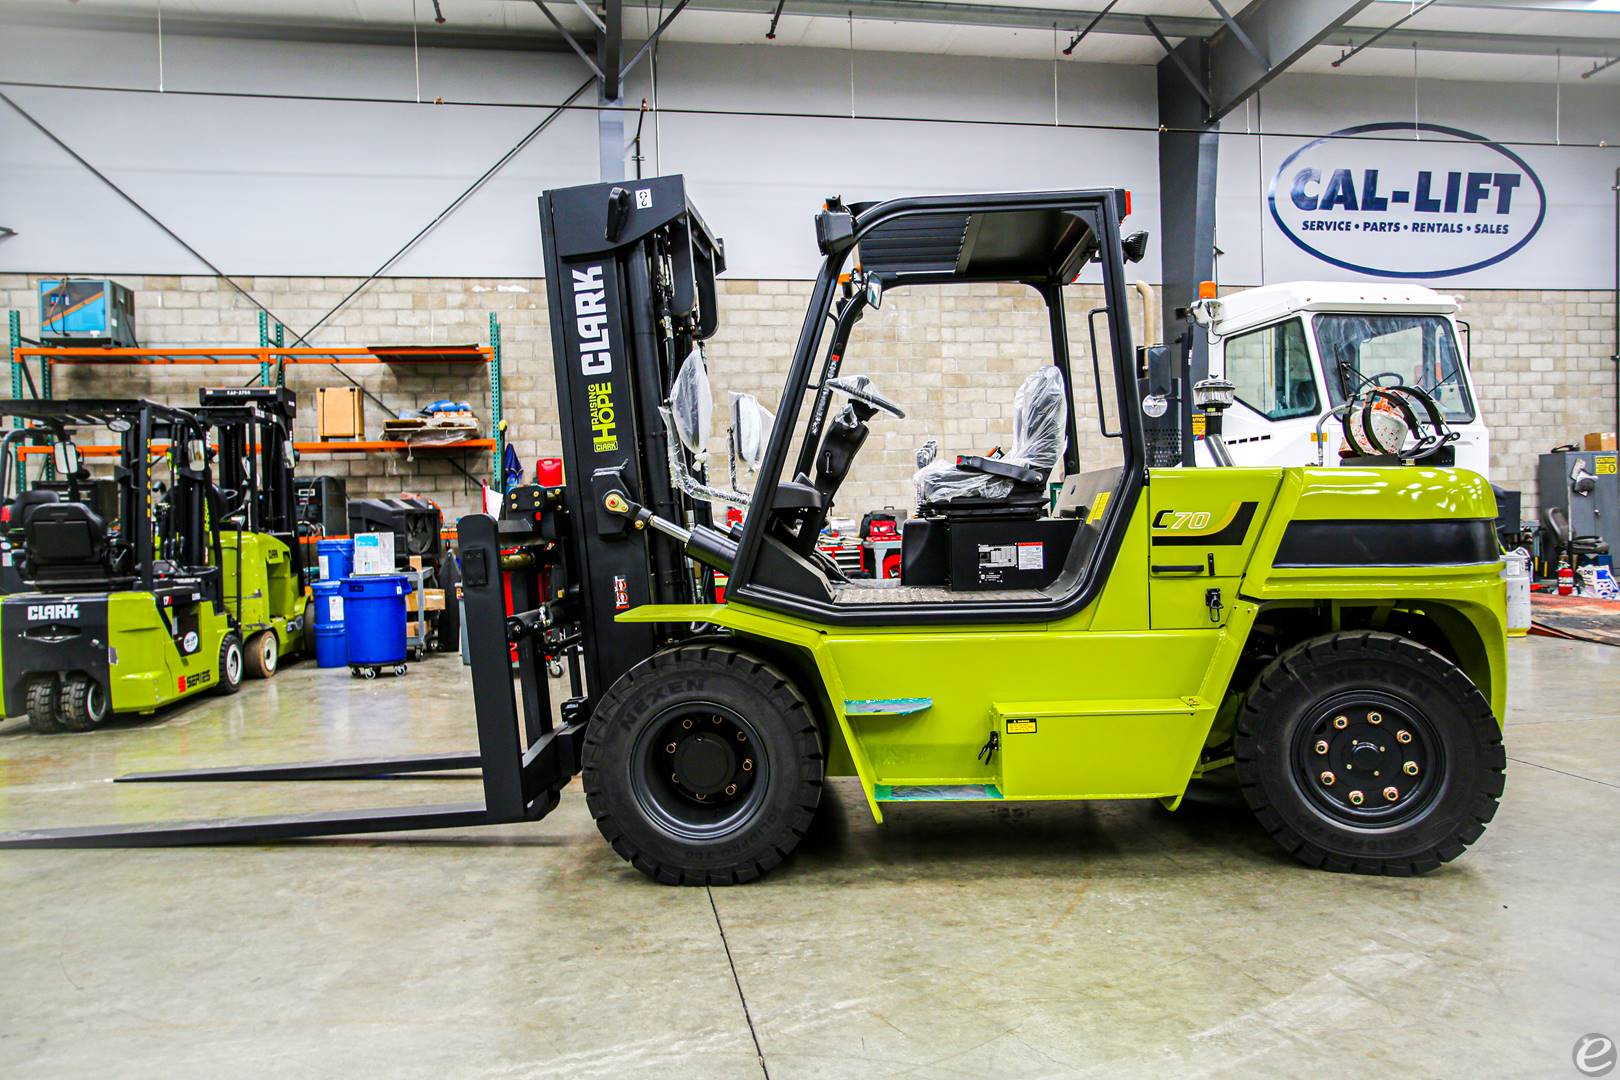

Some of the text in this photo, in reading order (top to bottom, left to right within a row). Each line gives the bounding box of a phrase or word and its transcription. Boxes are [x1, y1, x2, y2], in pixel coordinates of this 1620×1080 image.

[1290, 168, 1521, 214] CAL-LIFT
[1302, 220, 1509, 235] SERVICE PARTS RENTALS SALES
[572, 266, 612, 376] CLARK
[588, 384, 600, 425] RAISING
[592, 382, 617, 444] HOPE
[1152, 510, 1211, 529] C70
[27, 604, 80, 620] CLARK
[619, 679, 704, 731] NEXEN
